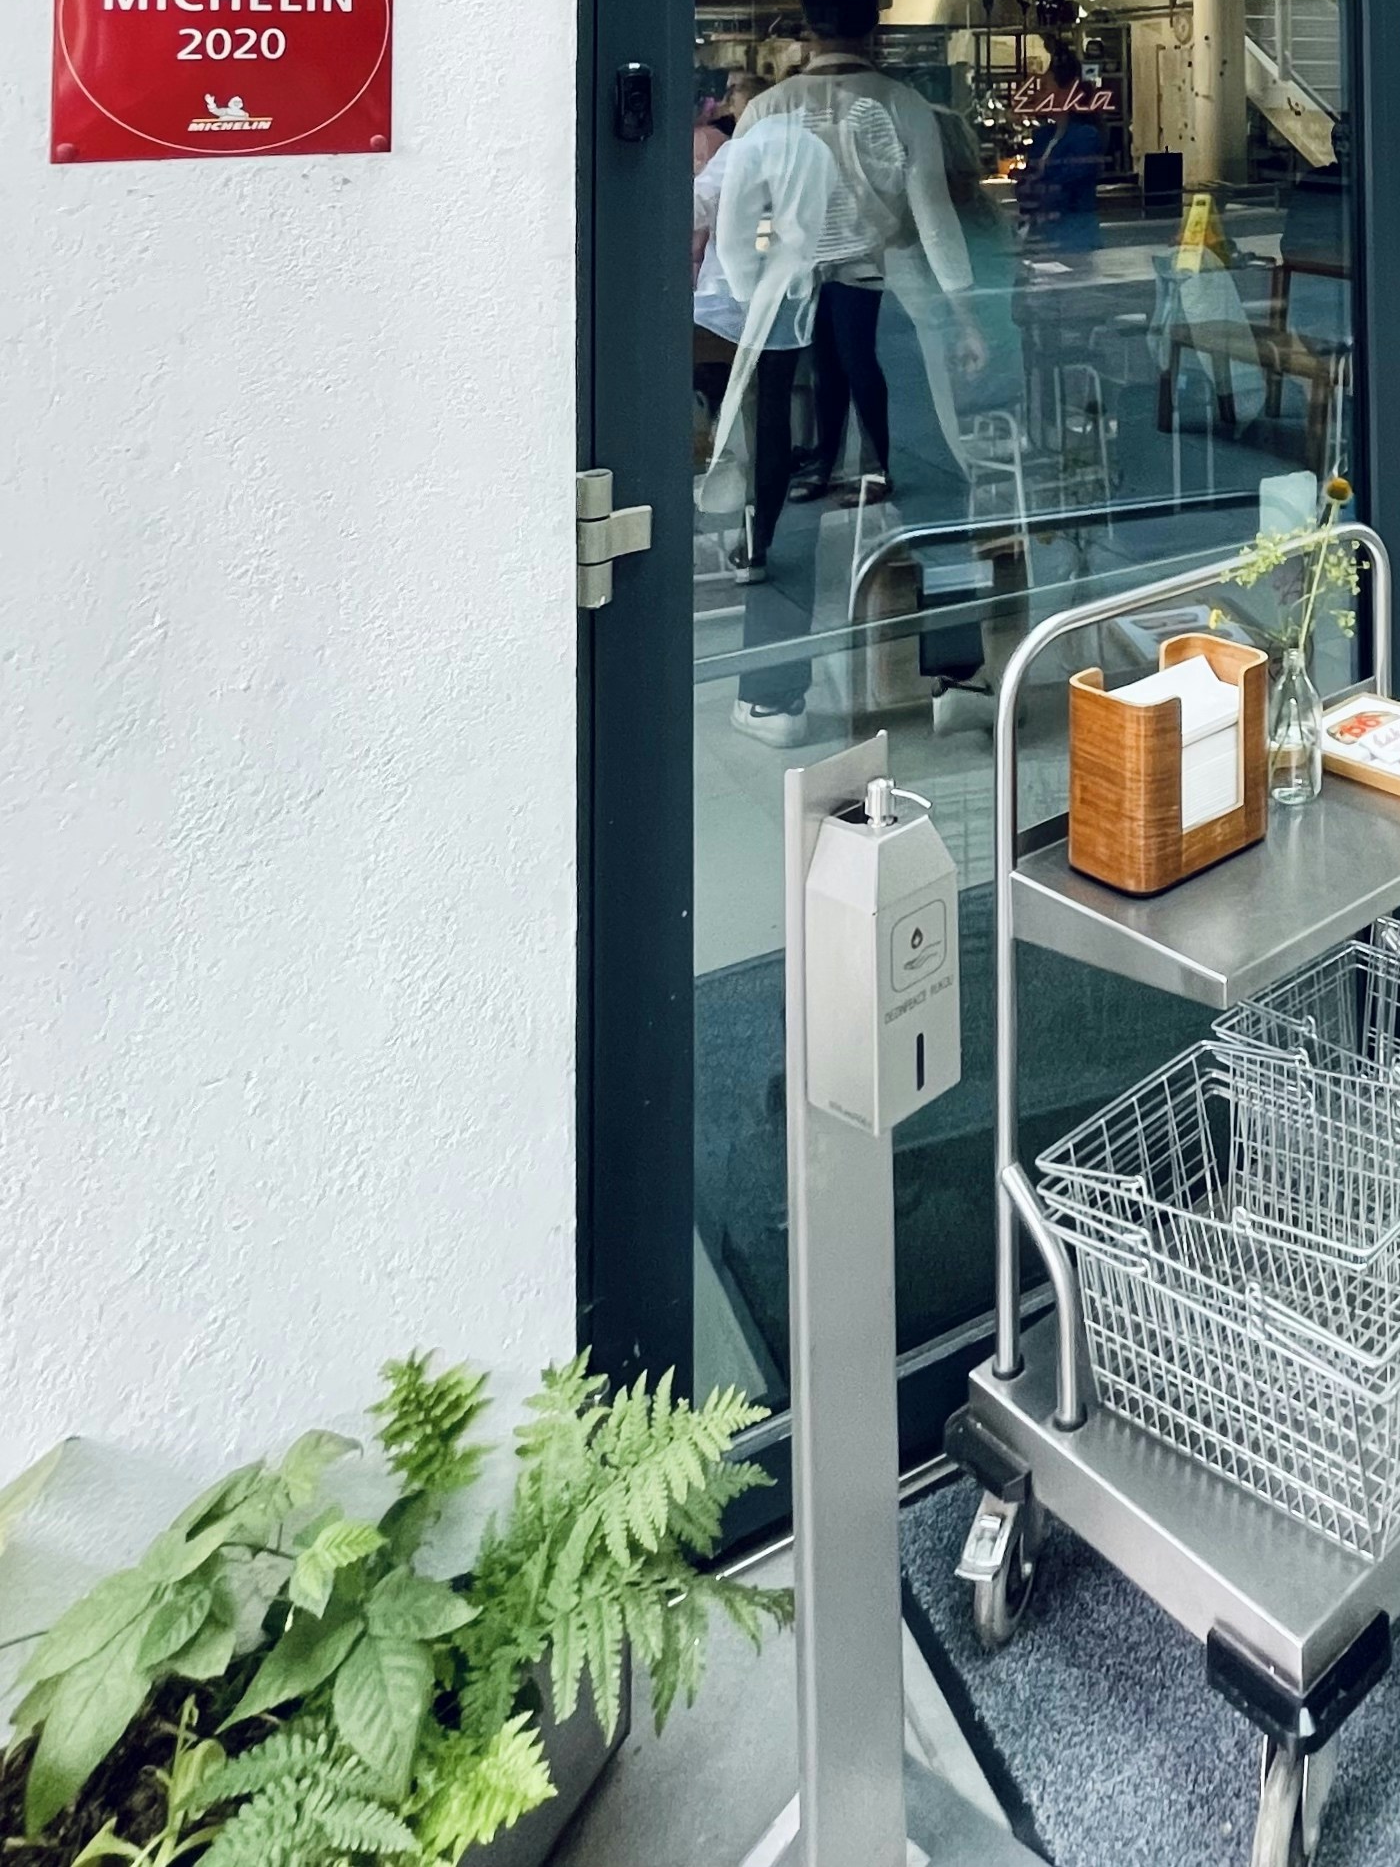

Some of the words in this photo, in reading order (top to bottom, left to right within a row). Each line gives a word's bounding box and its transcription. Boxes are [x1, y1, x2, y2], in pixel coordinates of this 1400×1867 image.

[176, 27, 286, 61] 2020
[1013, 76, 1115, 113] Eska
[187, 121, 271, 132] MICHELIN
